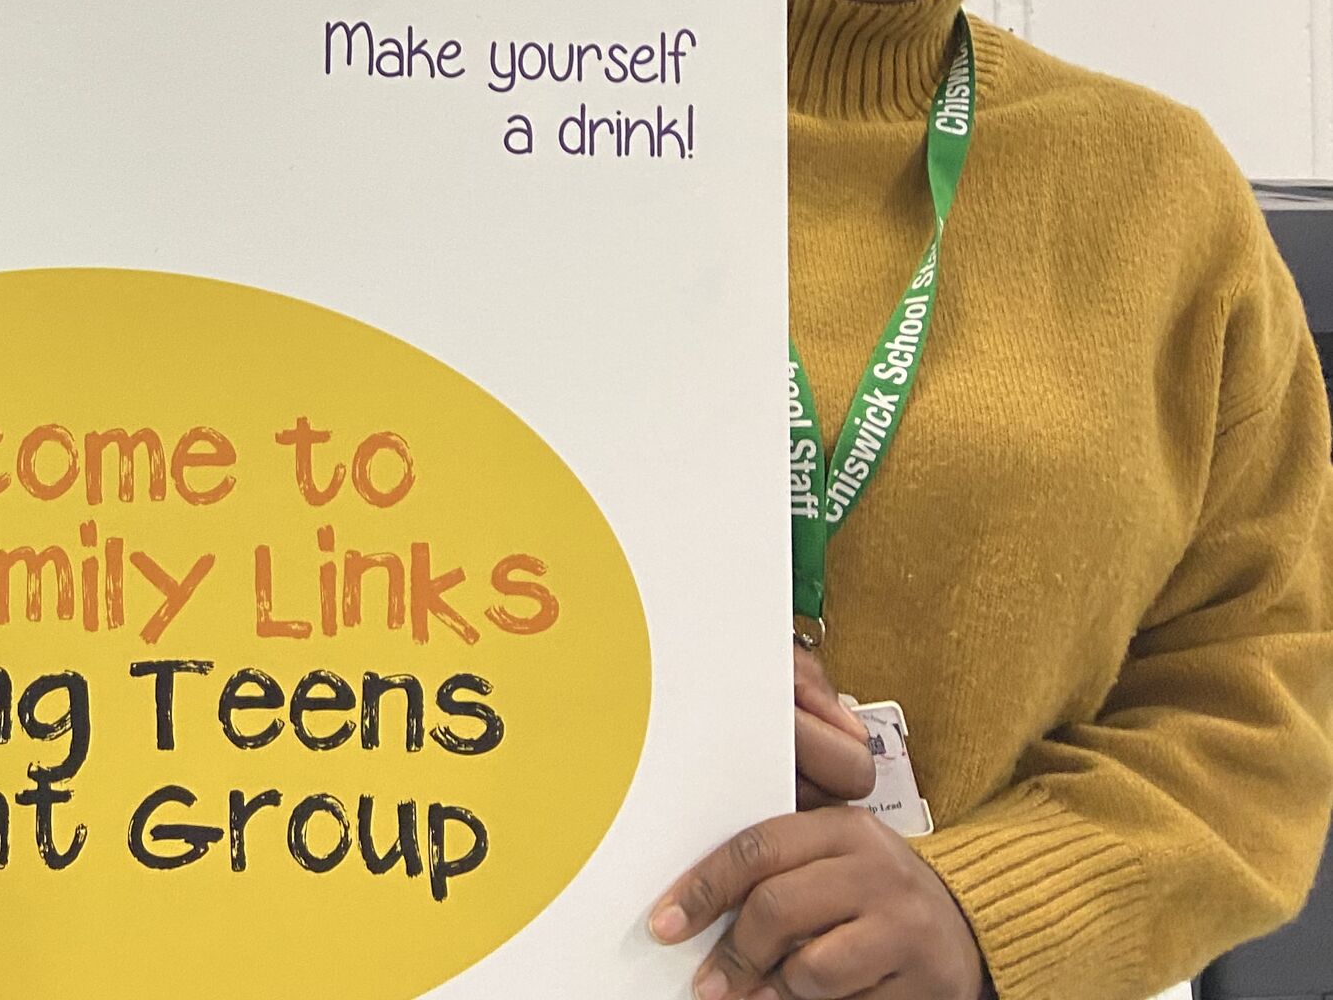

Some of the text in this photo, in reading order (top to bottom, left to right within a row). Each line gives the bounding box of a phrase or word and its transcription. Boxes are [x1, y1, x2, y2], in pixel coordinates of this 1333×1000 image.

[325, 21, 697, 93] Make yourself
[503, 102, 694, 160] a drink!
[825, 387, 900, 523] Chiswick
[873, 294, 930, 386] School
[272, 415, 417, 510] to
[790, 438, 819, 519] Staff
[253, 523, 561, 646] Links
[129, 659, 506, 756] Teens
[127, 784, 490, 904] Group
